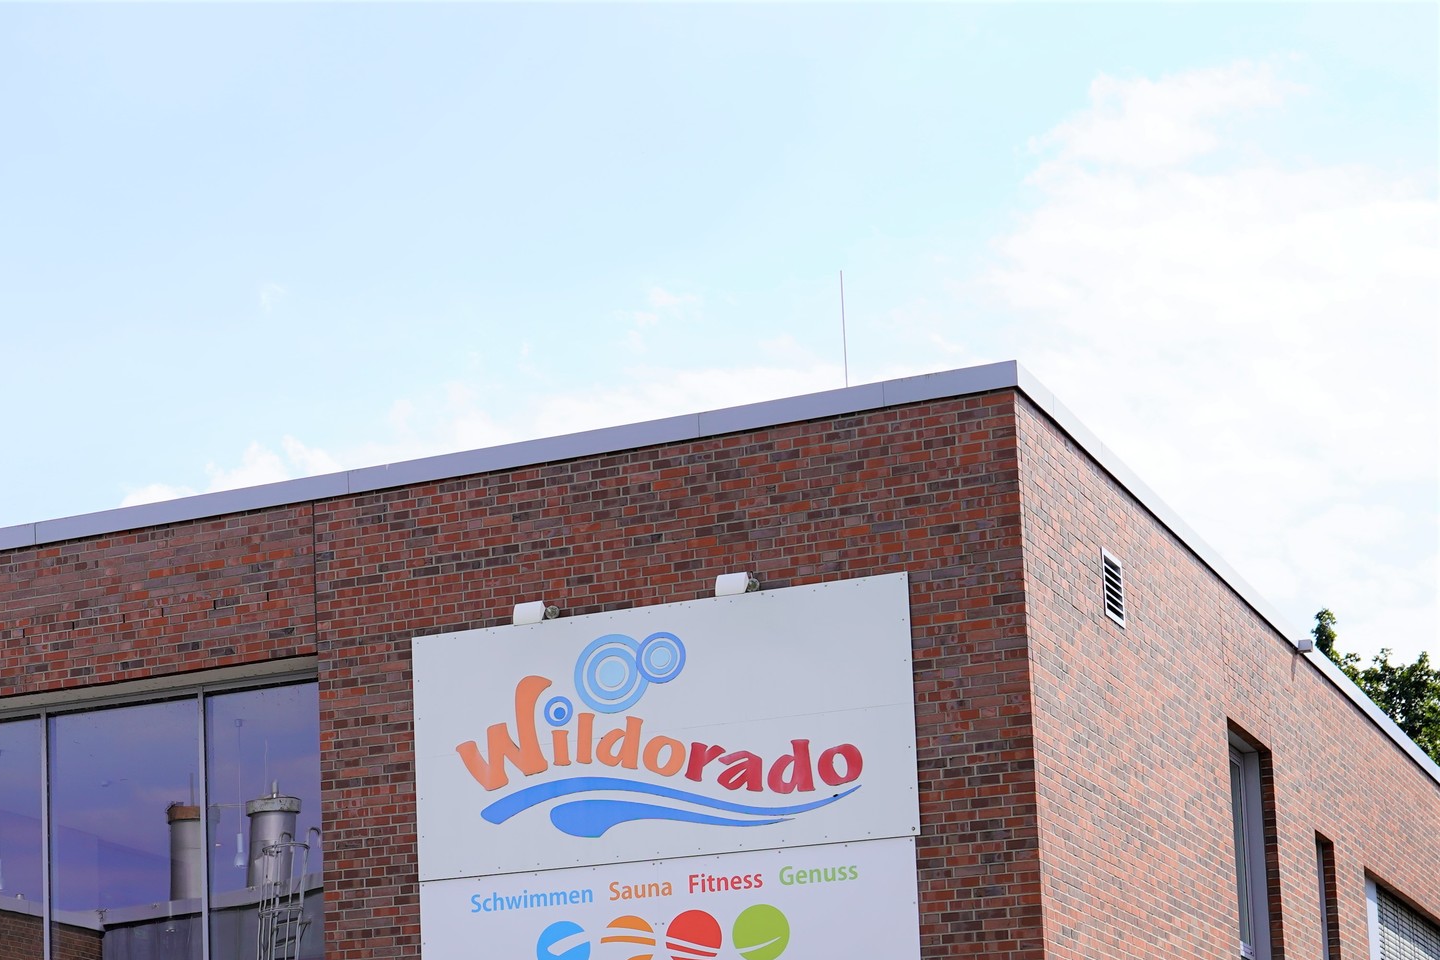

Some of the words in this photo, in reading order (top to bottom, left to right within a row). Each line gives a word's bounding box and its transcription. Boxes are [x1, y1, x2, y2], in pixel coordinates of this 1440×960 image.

[456, 675, 863, 793] Wildorado
[471, 888, 593, 913] Schwimmen
[609, 879, 672, 901] Sauna
[688, 872, 763, 894] Fitness
[779, 865, 859, 887] Genuss
